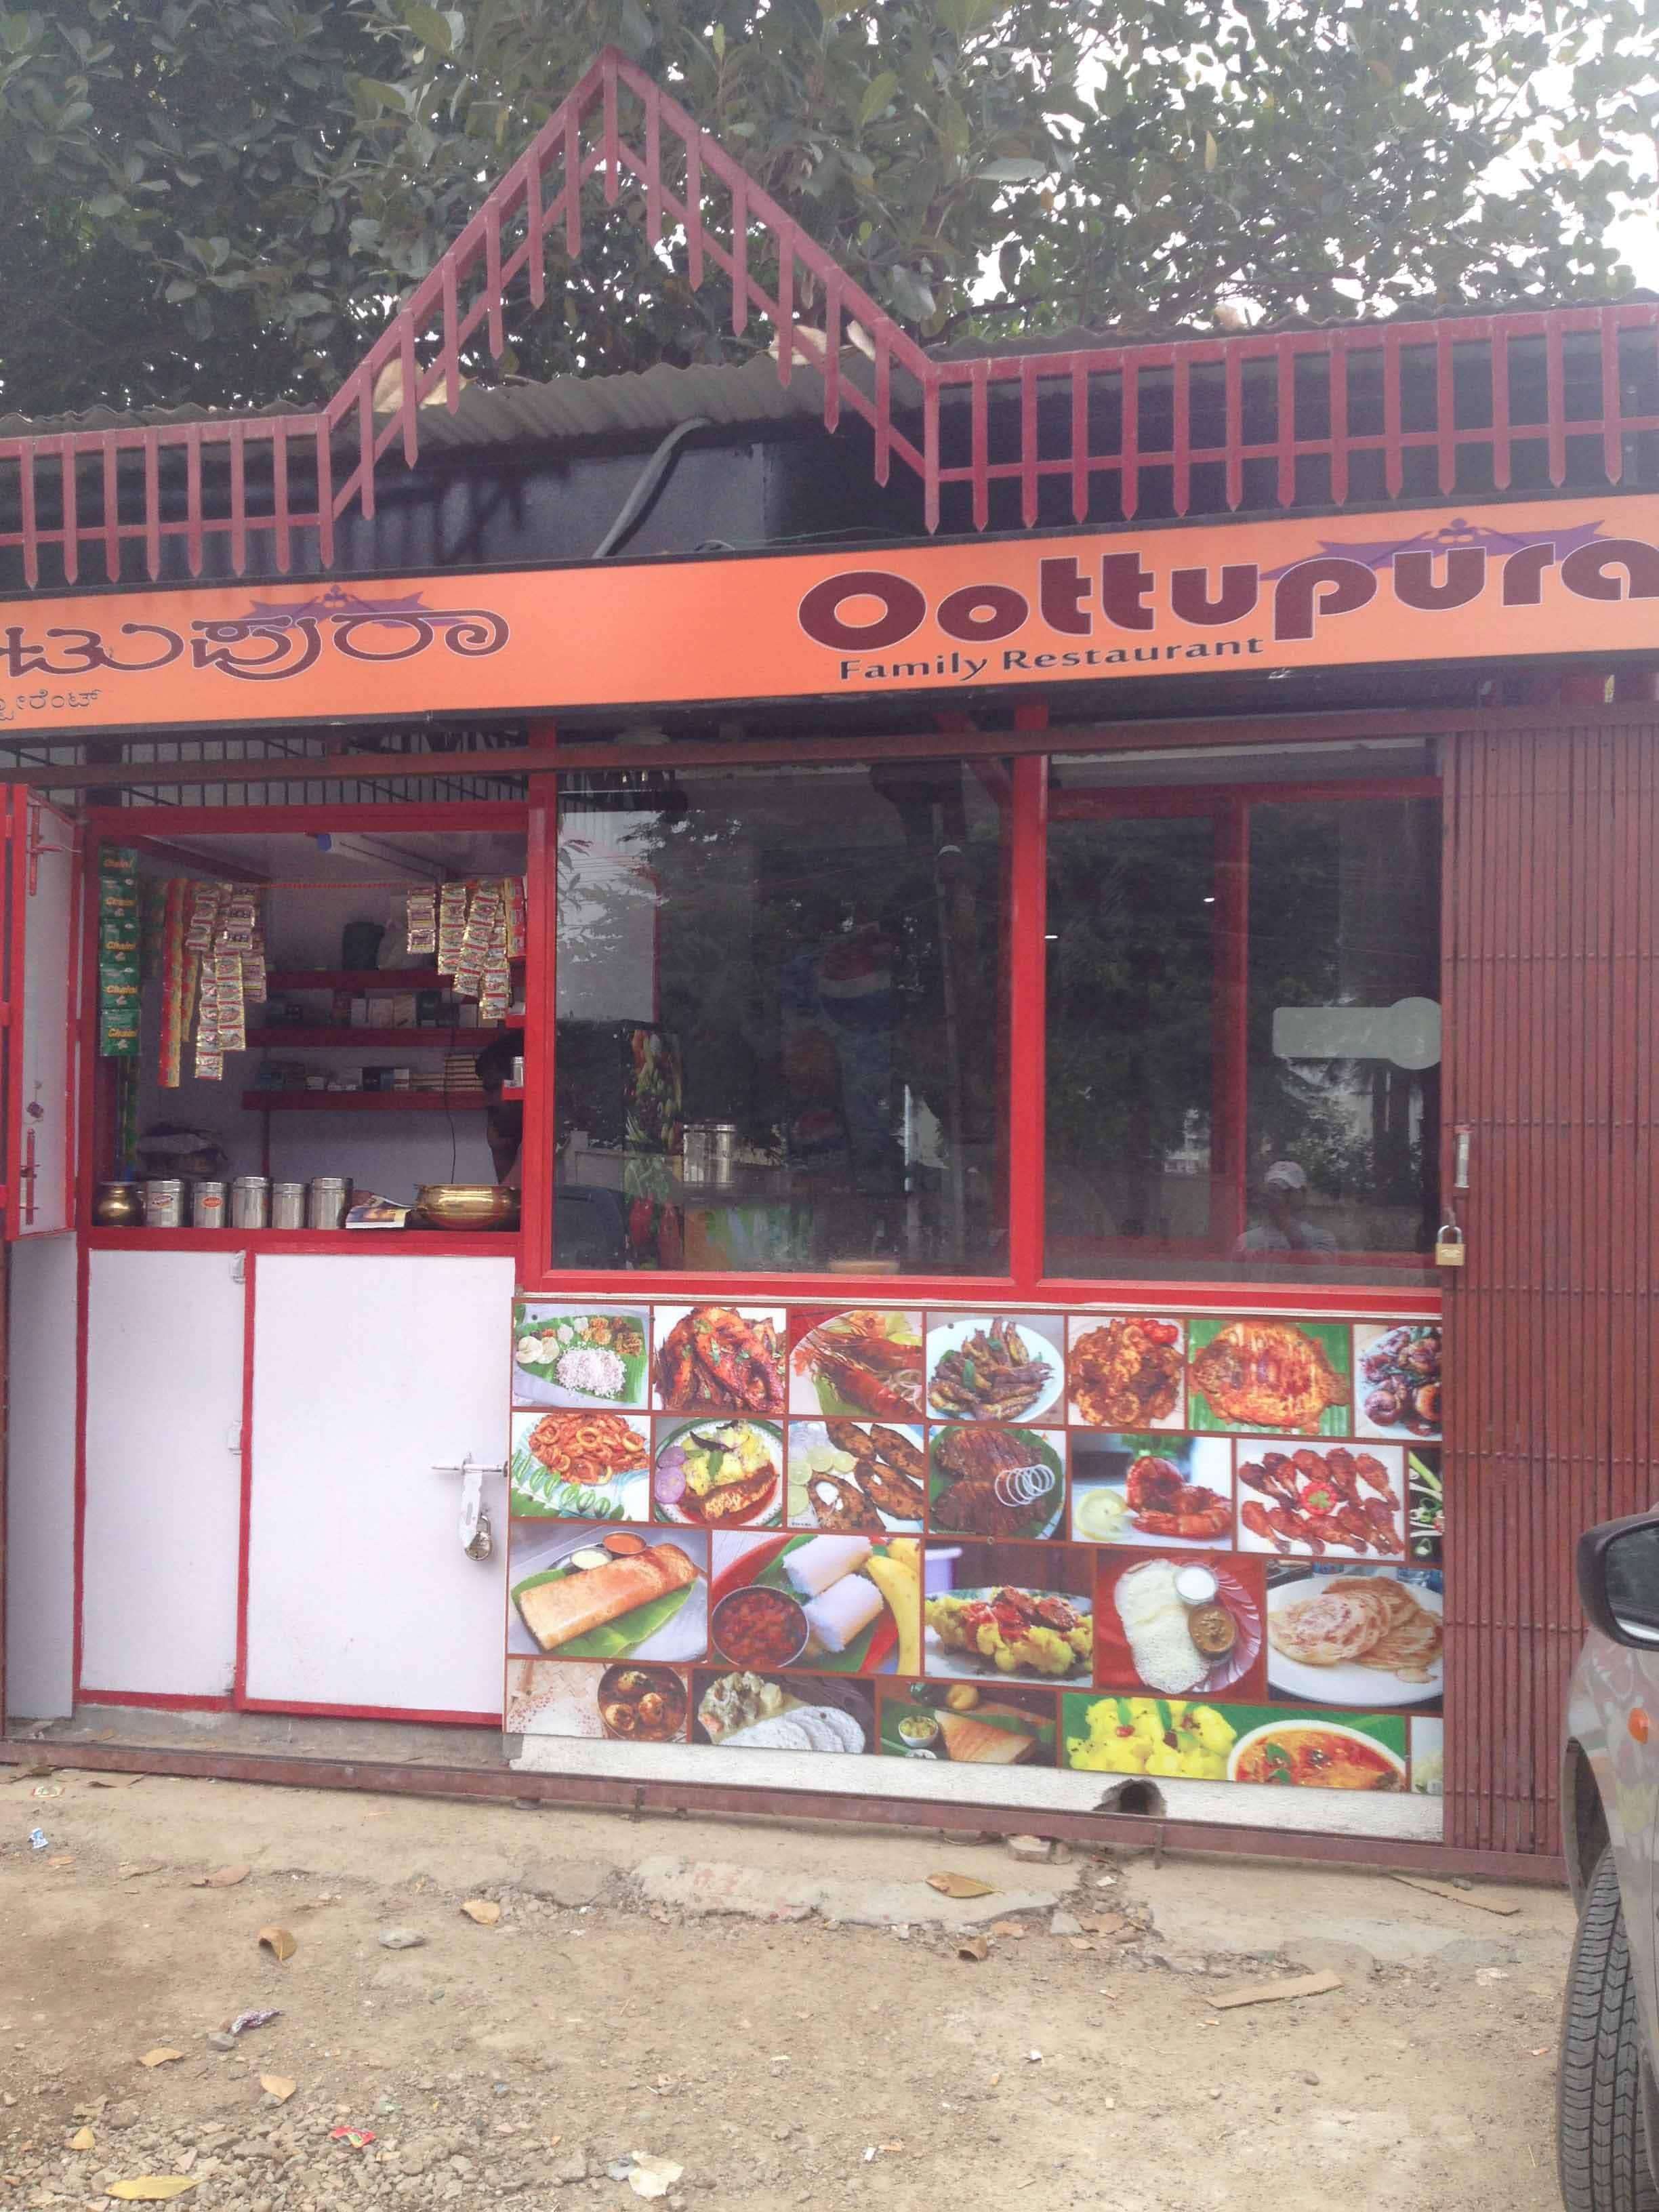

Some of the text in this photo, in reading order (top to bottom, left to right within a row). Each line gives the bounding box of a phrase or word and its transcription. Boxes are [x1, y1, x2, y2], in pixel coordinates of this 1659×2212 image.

[798, 538, 1659, 651] Oottupura
[840, 638, 1264, 681] Family Restaurant
